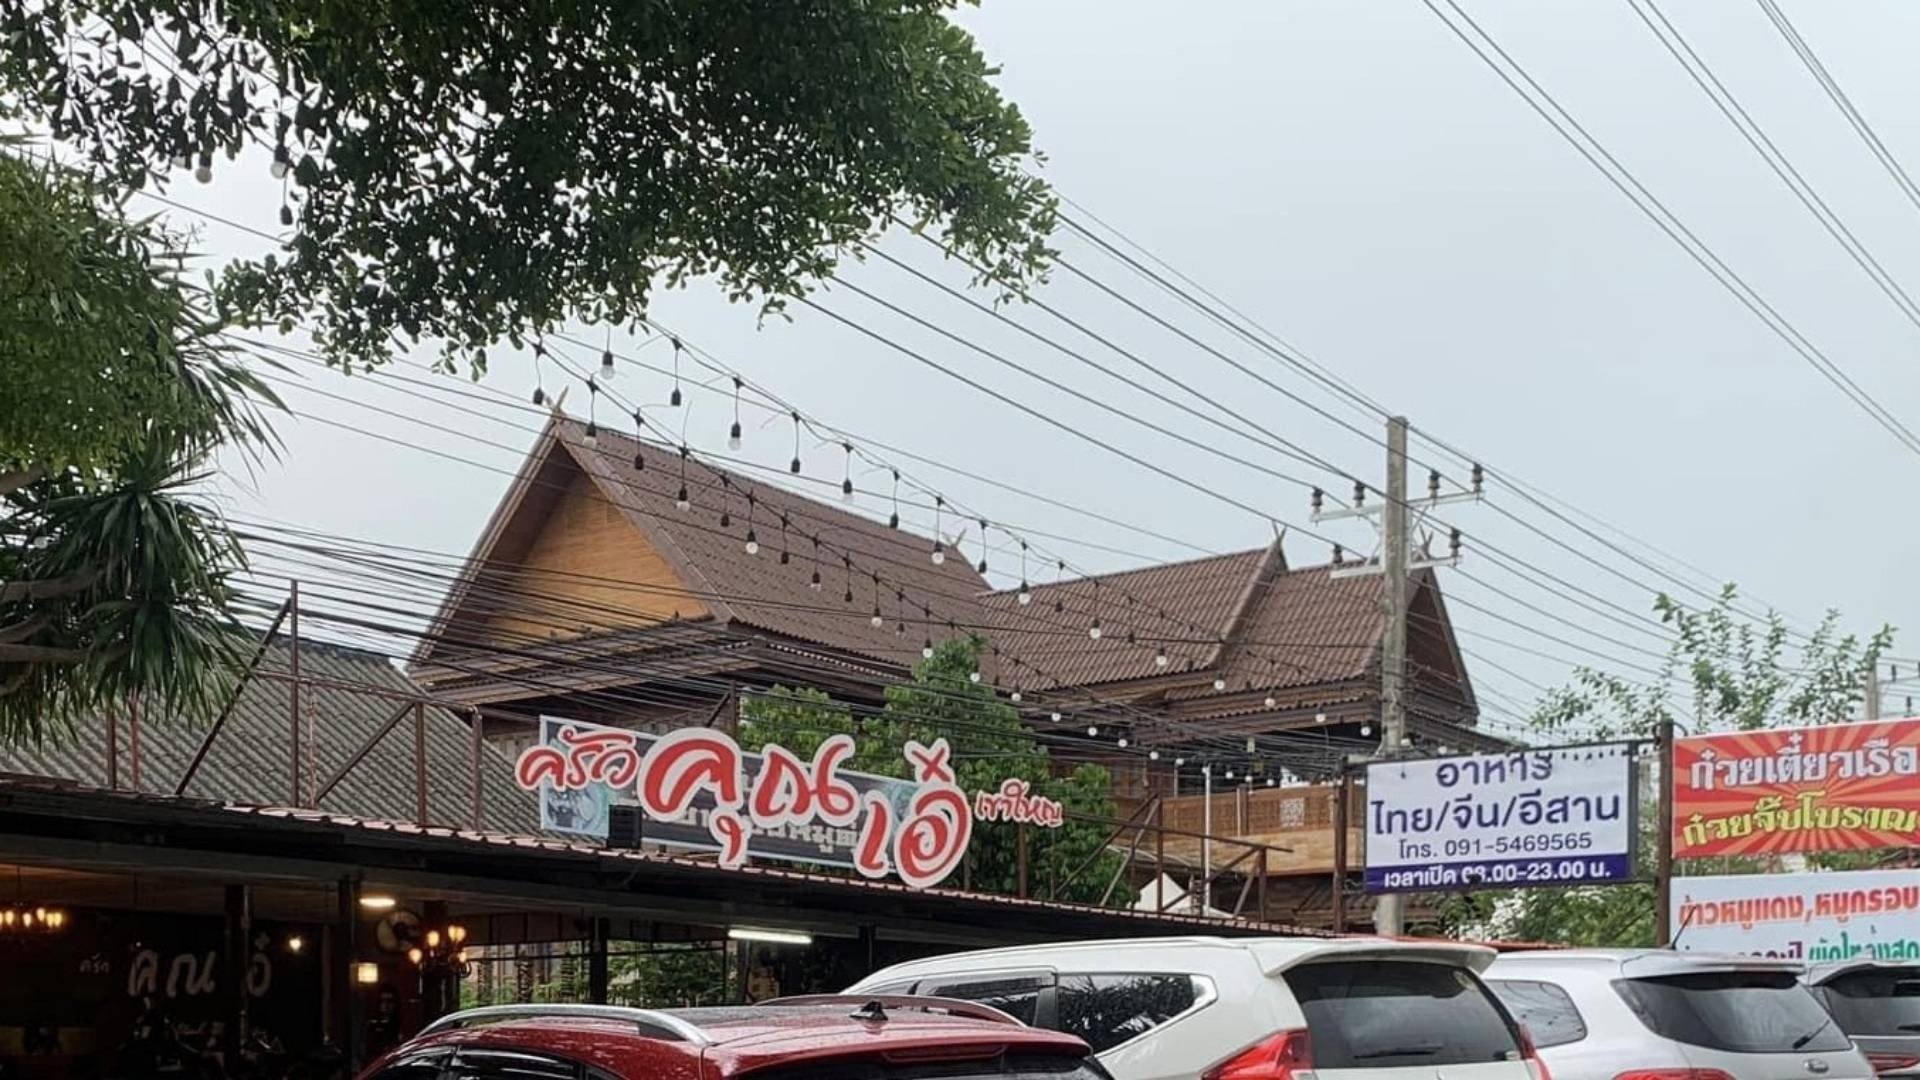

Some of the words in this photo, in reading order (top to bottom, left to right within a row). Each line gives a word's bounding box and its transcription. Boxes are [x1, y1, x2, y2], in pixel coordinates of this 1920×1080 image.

[515, 725, 641, 791] ครัว
[1436, 750, 1553, 788] อาหาร
[1371, 789, 1620, 836] ไทย/จีน/อีสาน
[1399, 840, 1438, 860] โทร.
[1444, 832, 1593, 857] 091-5469565
[1384, 866, 1457, 889] เวลาเปิด
[1590, 861, 1612, 879] น.
